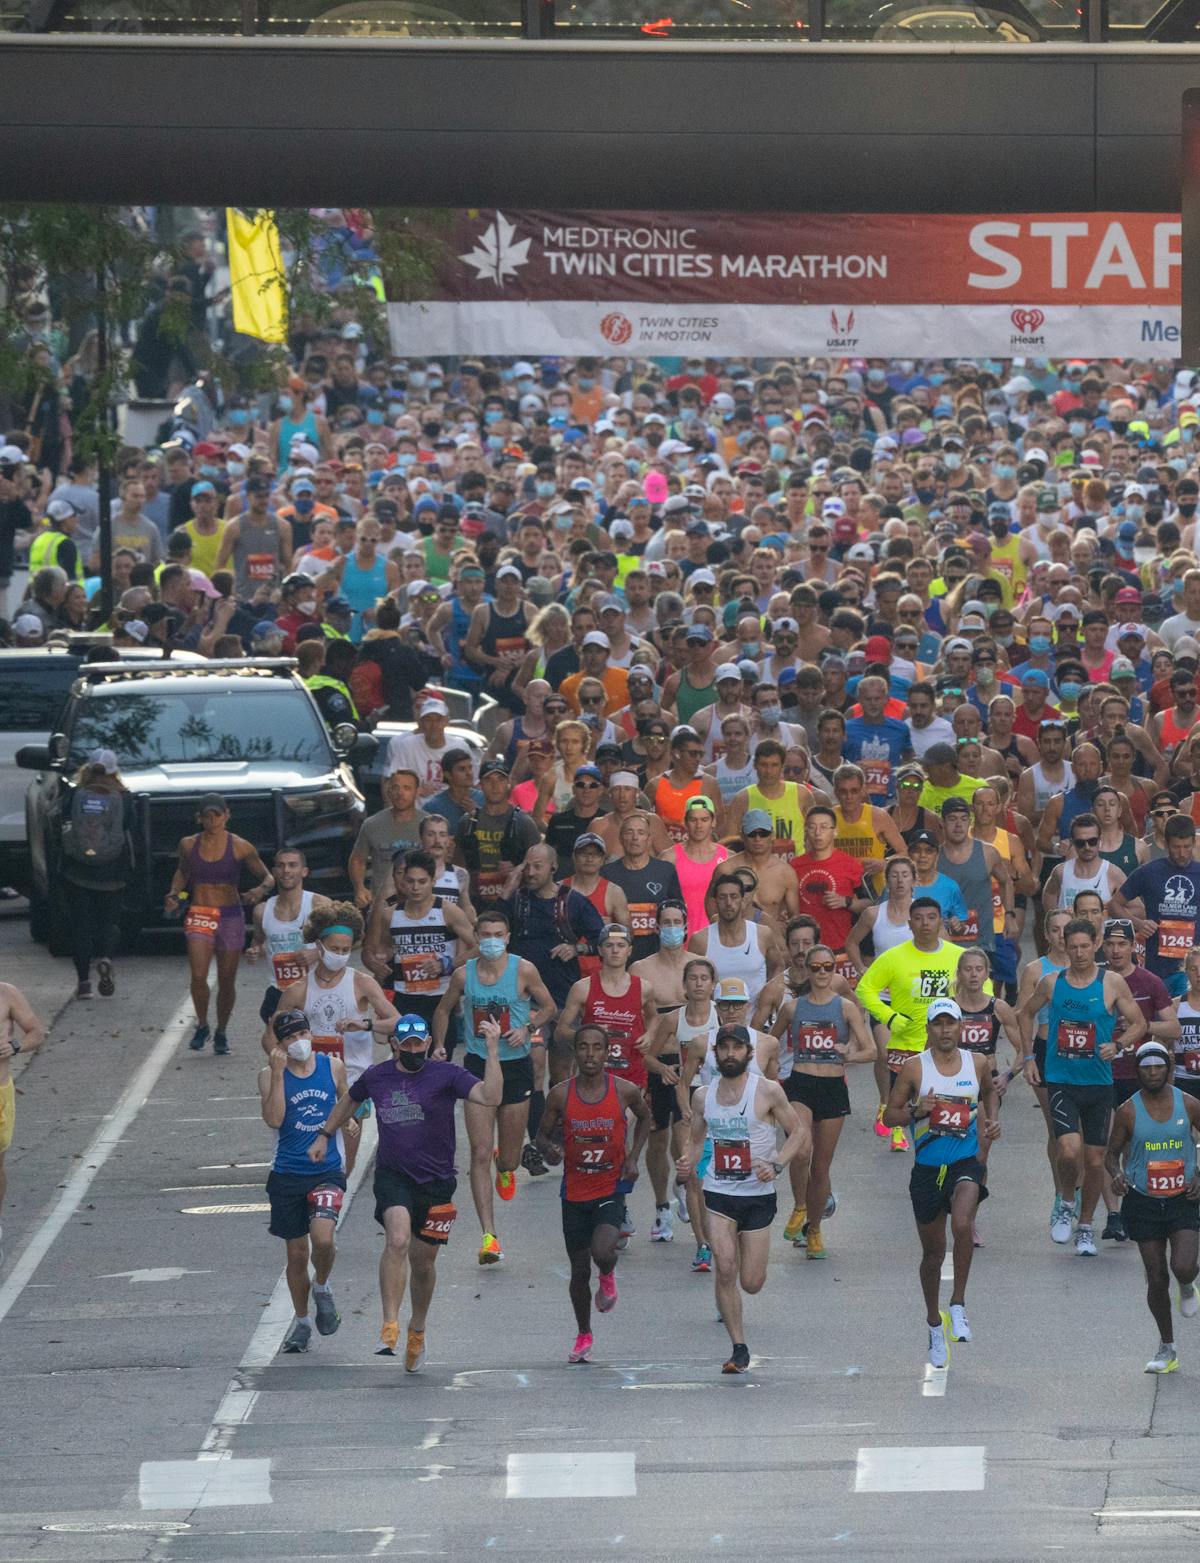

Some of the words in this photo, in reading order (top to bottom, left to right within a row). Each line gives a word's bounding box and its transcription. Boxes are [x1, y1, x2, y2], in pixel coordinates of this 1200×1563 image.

[543, 227, 697, 249] MEDTRONIC
[543, 252, 616, 277] TWIN
[623, 253, 713, 278] CITIES
[721, 255, 888, 279] MARATHON
[639, 317, 673, 328] TWIN
[677, 317, 719, 328] CITIES
[639, 331, 654, 341] IN
[657, 331, 712, 341] MOTION
[1010, 334, 1045, 344] iHeart
[826, 339, 859, 347] USATF
[1161, 934, 1194, 947] 1245
[804, 1035, 834, 1048] 106
[961, 1029, 990, 1042] 102
[1068, 1035, 1087, 1048] 19
[290, 1089, 329, 1104] BOSTON
[939, 1110, 962, 1125] 24
[582, 1149, 605, 1164] 27
[723, 1155, 742, 1169] 12
[1150, 1175, 1184, 1190] 1219
[317, 1193, 334, 1207] 11
[424, 1219, 455, 1232] 226
